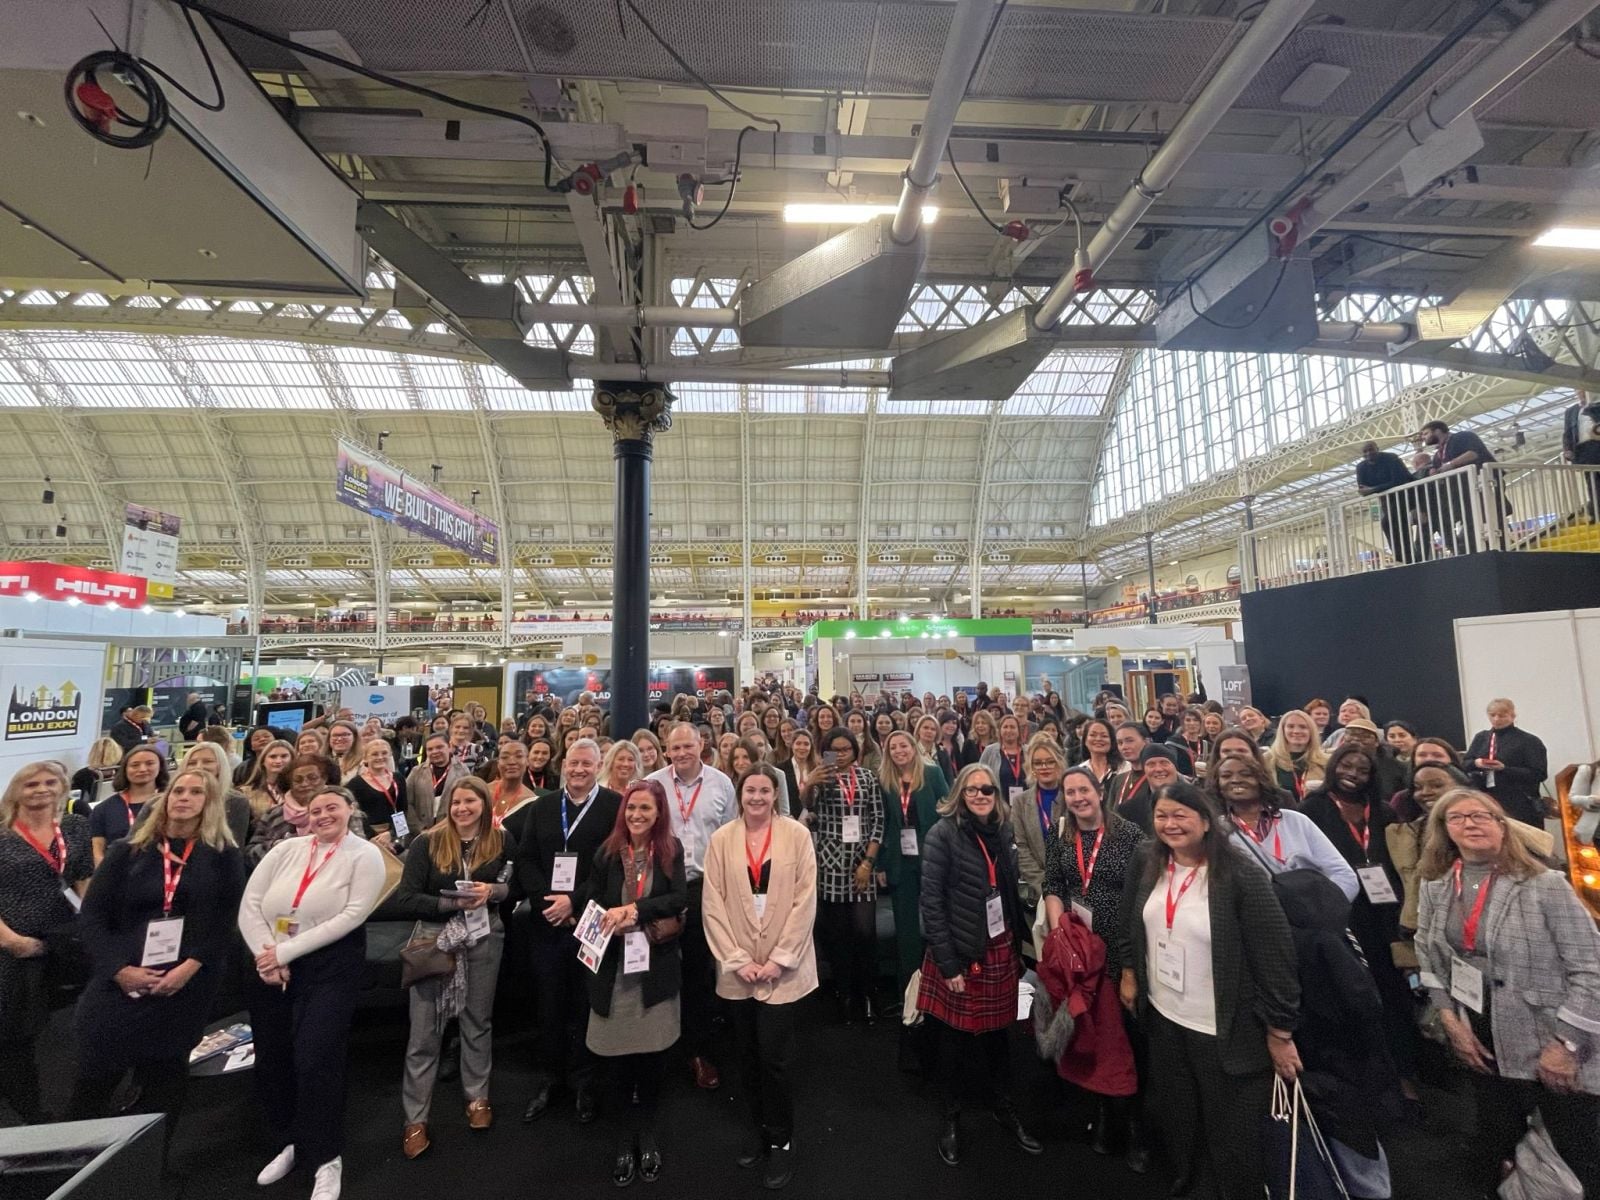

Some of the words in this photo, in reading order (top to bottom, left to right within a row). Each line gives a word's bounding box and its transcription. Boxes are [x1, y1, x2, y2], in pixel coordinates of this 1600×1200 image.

[384, 481, 403, 513] WE
[405, 491, 432, 526] BUILT
[434, 506, 453, 536] THIS
[454, 517, 475, 546] CITY!
[55, 577, 137, 600] HILTI
[1223, 680, 1242, 692] LOFT
[9, 710, 77, 723] LONDON
[8, 722, 45, 732] BUILD
[47, 720, 77, 730] EXPO
